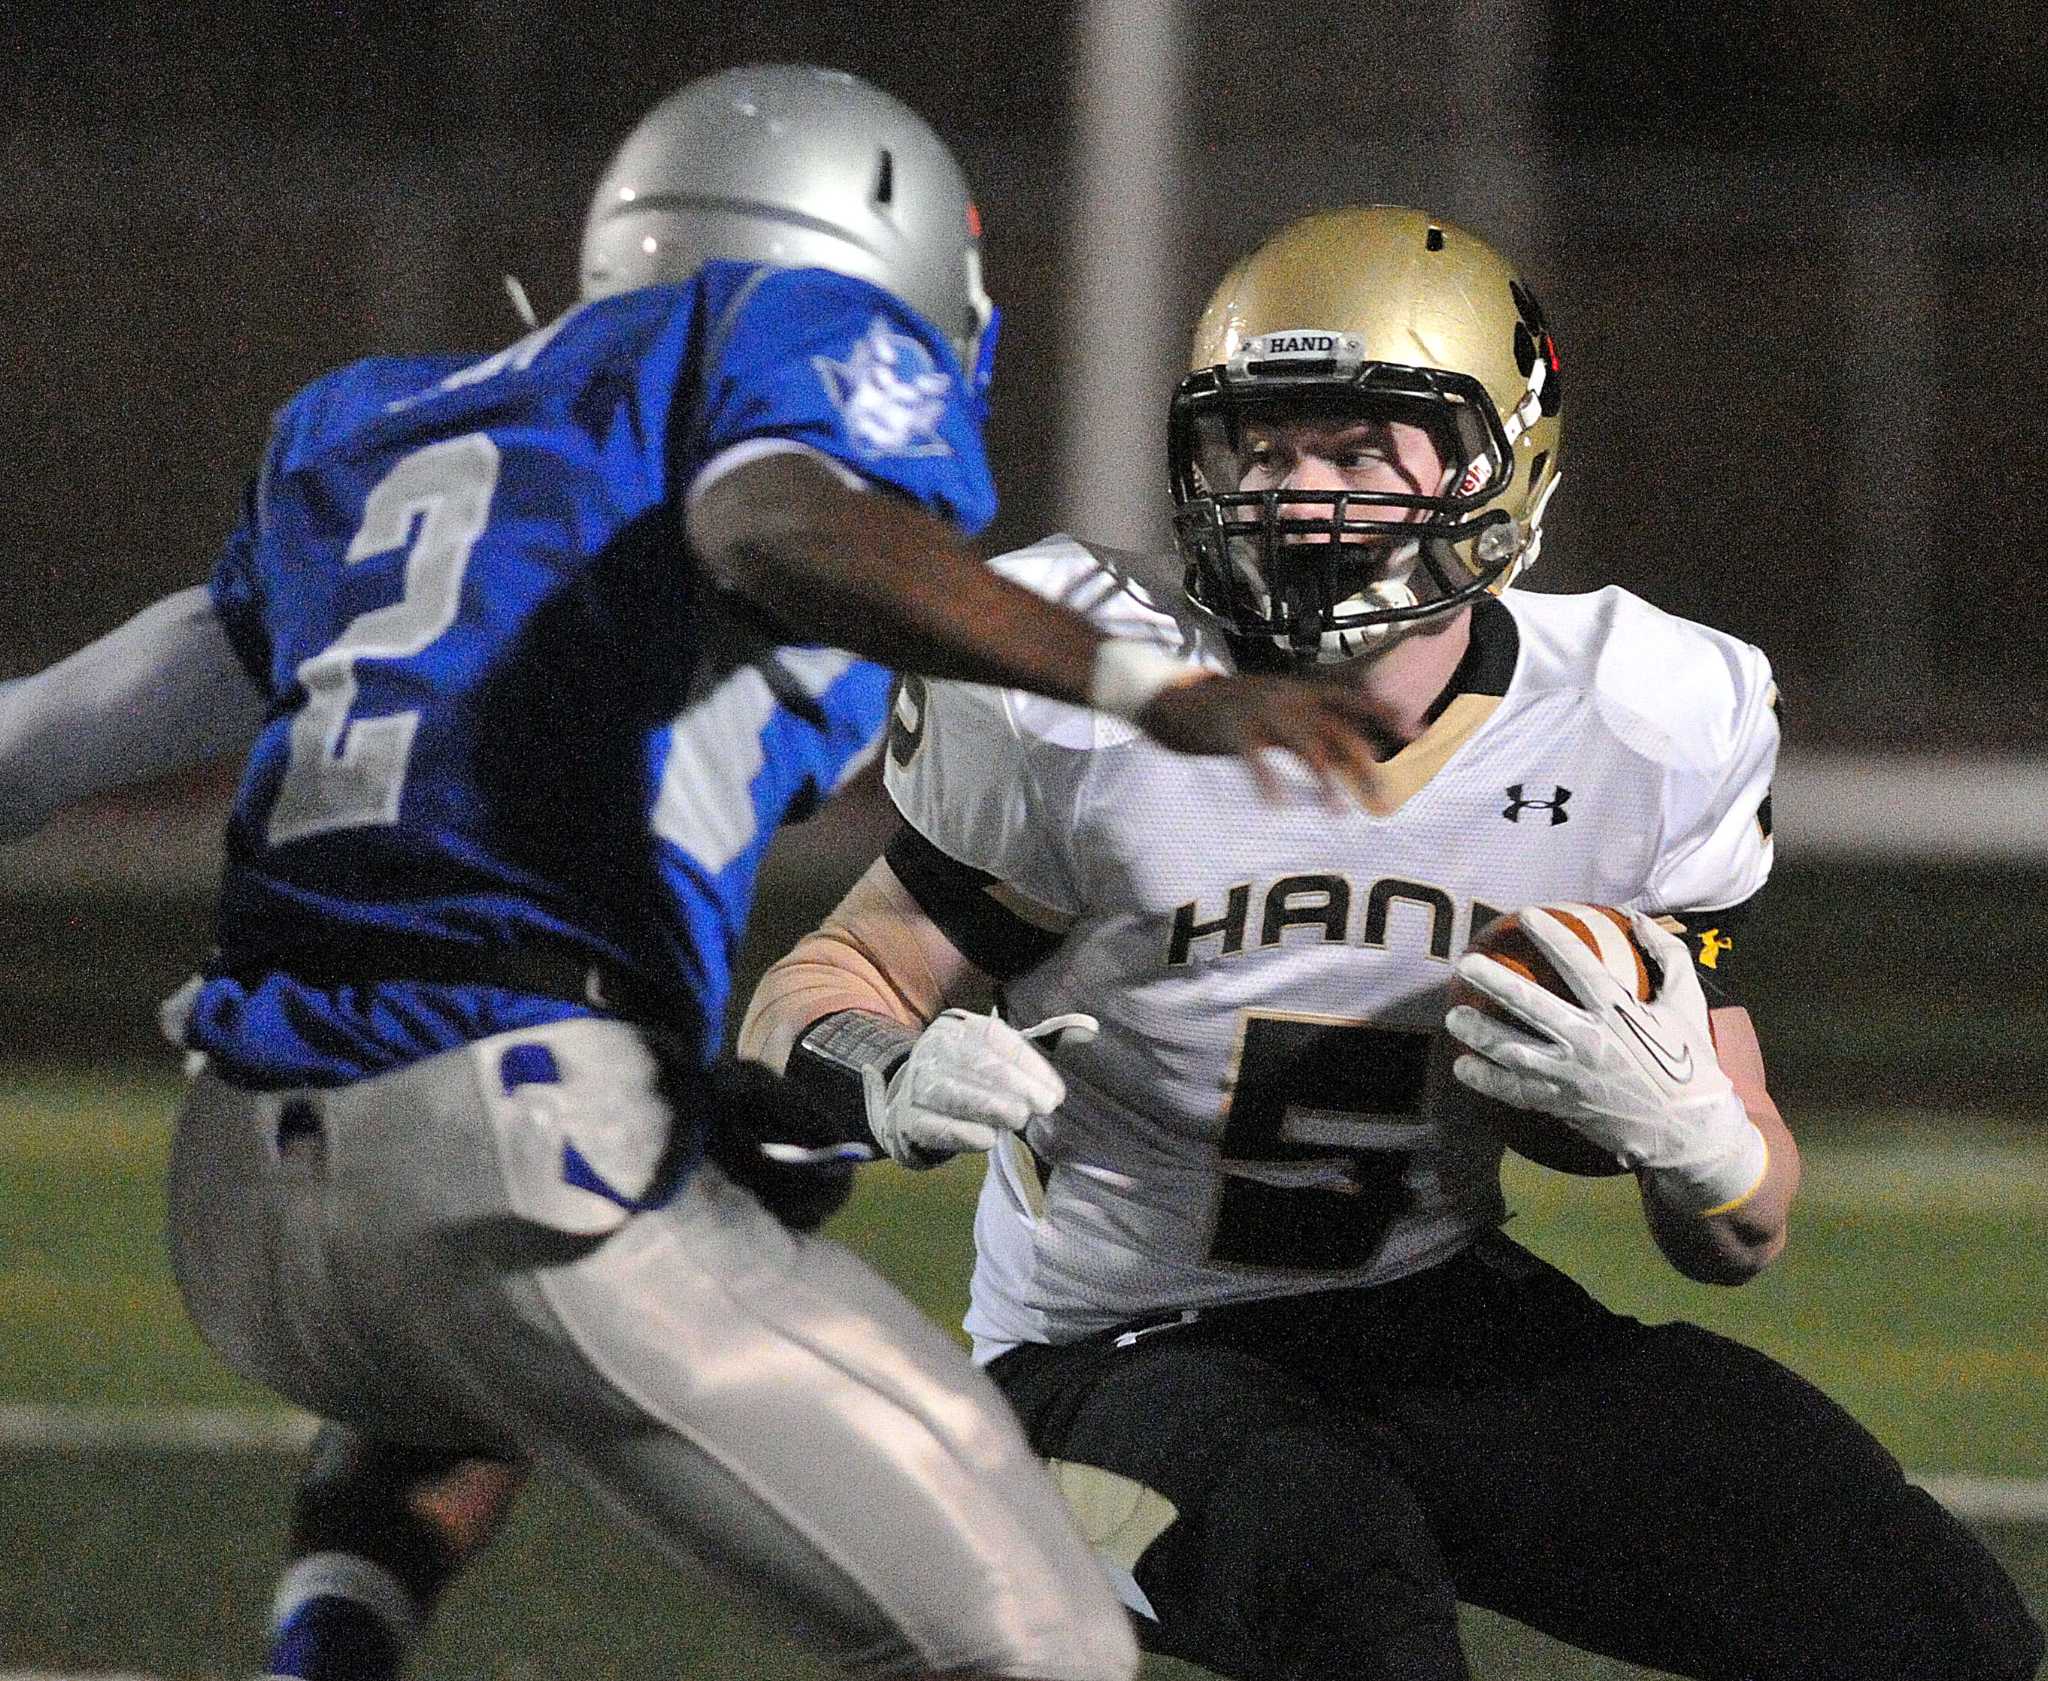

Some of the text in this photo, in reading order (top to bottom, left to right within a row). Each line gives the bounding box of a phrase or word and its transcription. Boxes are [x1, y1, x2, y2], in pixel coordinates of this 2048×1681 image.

[1270, 337, 1333, 353] HAND
[267, 432, 500, 847] 2
[1208, 1008, 1434, 1270] 5
